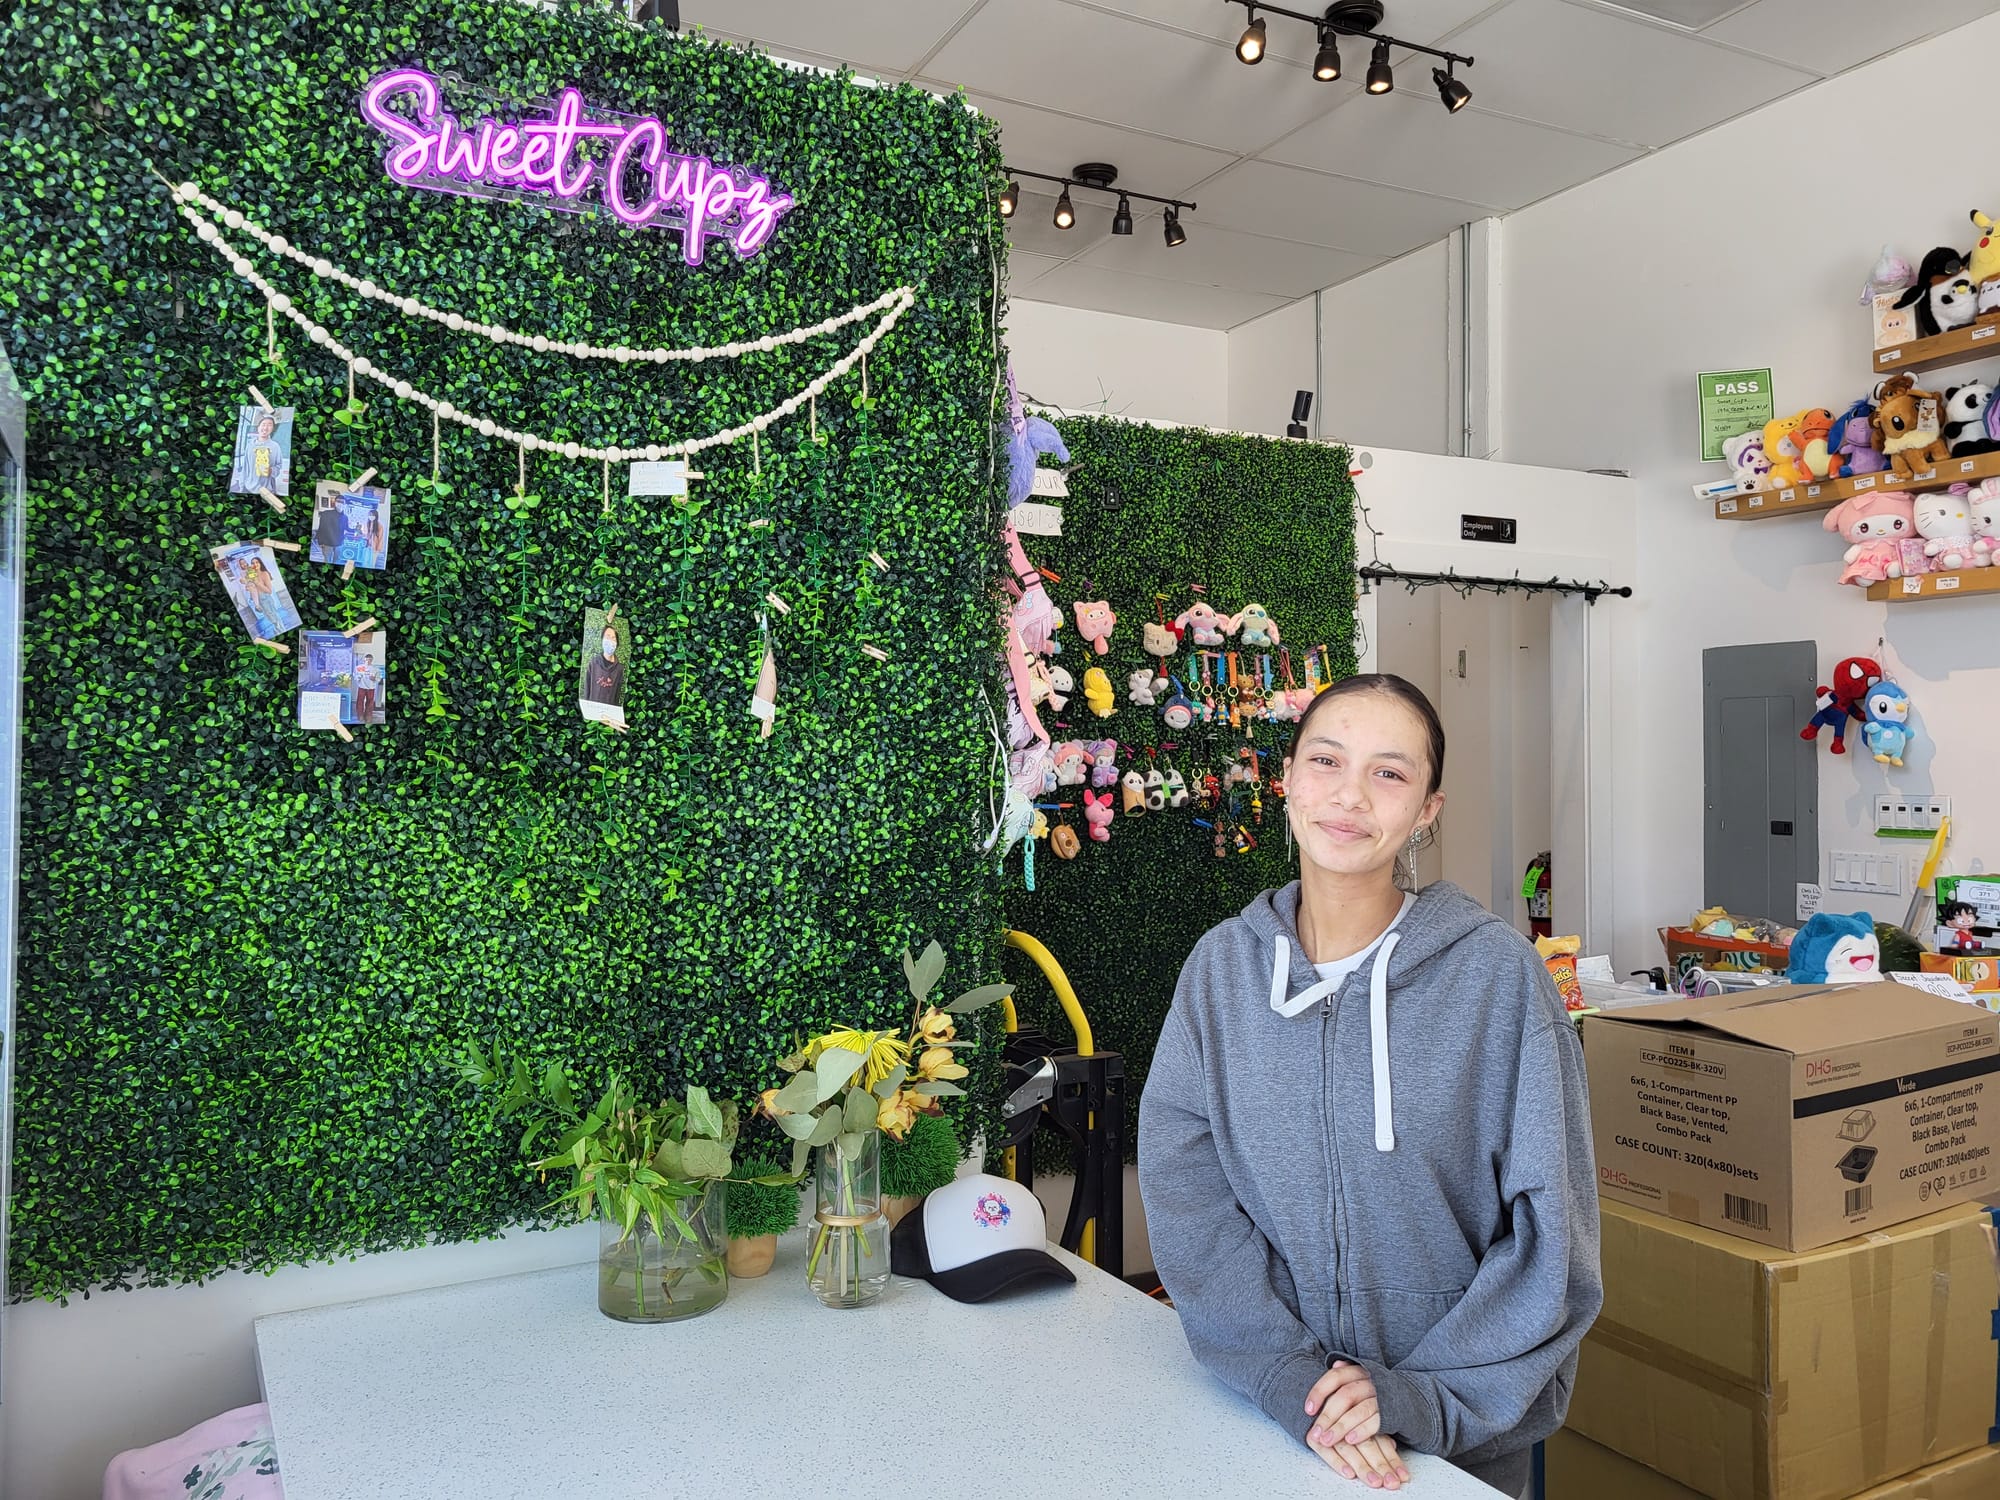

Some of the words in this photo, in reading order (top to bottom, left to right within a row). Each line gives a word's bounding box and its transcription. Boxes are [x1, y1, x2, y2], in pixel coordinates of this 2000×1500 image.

[366, 70, 624, 197] Sweet
[608, 119, 790, 259] Cupz
[1715, 381, 1759, 395] PASS
[1463, 521, 1494, 530] Employees
[1463, 530, 1477, 539] Only
[1669, 1044, 1688, 1055] ITEM
[1806, 1059, 1831, 1079] DHG
[1630, 1075, 1649, 1088] 6x6,
[1651, 1080, 1723, 1103] 1-Compartment
[1725, 1095, 1738, 1106] PP
[1904, 1099, 1919, 1113] 6x6,
[1921, 1087, 1973, 1108] 1-Compartment
[1974, 1083, 1983, 1095] PP
[1637, 1090, 1683, 1110] Container,
[1685, 1101, 1709, 1114] Clear
[1712, 1107, 1731, 1121] top,
[1910, 1110, 1946, 1127] Container,
[1947, 1104, 1964, 1117] Clear
[1965, 1101, 1979, 1113] top,
[1640, 1104, 1664, 1118] Black
[1665, 1110, 1690, 1125] Base,
[1691, 1117, 1728, 1135] Vented,
[1912, 1127, 1931, 1142] Black
[1931, 1124, 1950, 1137] Base,
[1951, 1115, 1977, 1131] Vented,
[1656, 1122, 1688, 1138] Combo
[1690, 1130, 1712, 1144] Pack
[1924, 1138, 1949, 1154] Combo
[1950, 1133, 1966, 1147] Pack
[1615, 1135, 1640, 1150] CASE
[1642, 1142, 1682, 1160] COUNT:
[1684, 1152, 1759, 1181] 320(4x80)sets
[1899, 1165, 1917, 1180] CASE
[1918, 1158, 1945, 1175] COUNT:
[1945, 1146, 1990, 1167] 320(4x80)sets
[1600, 1166, 1628, 1185] DHG
